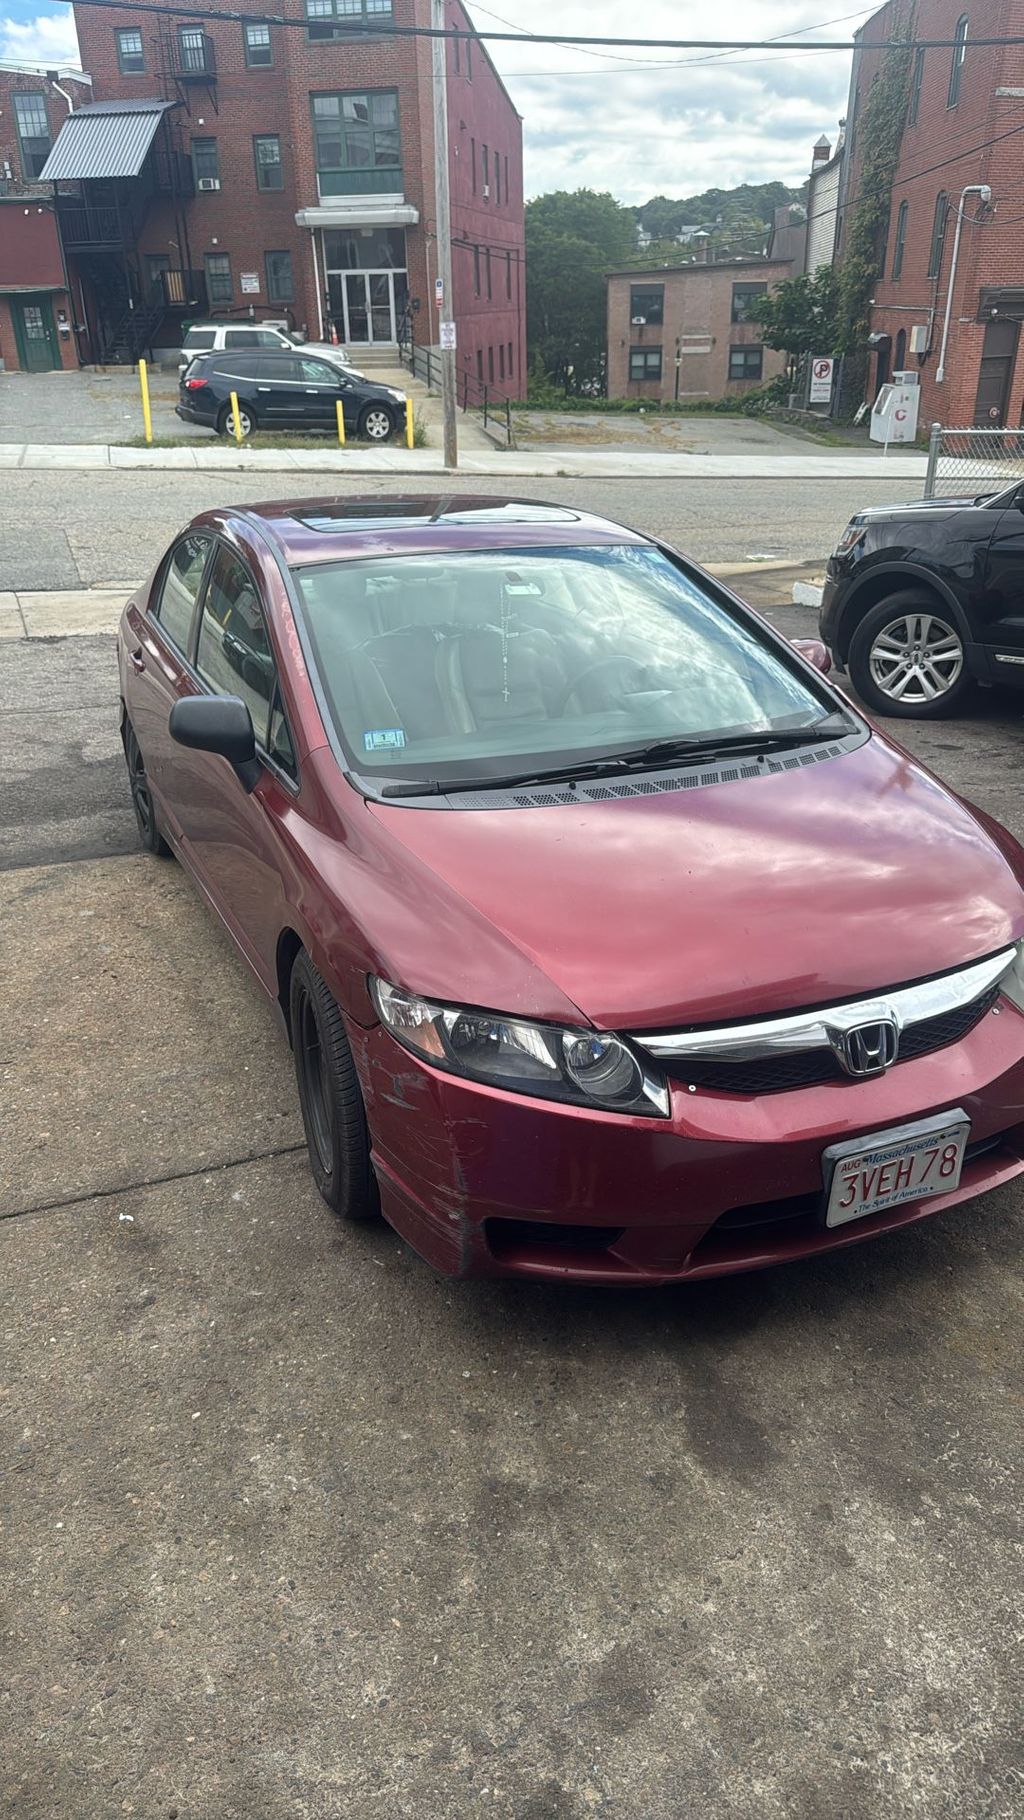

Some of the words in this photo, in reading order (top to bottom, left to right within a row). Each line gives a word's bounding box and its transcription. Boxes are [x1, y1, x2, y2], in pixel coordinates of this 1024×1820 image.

[865, 1136, 940, 1165] Massachusetts
[841, 1159, 861, 1172] AUG
[858, 1203, 871, 1212] The
[872, 1195, 891, 1208] Spirit
[892, 1192, 899, 1202] of
[900, 1187, 929, 1199] America
